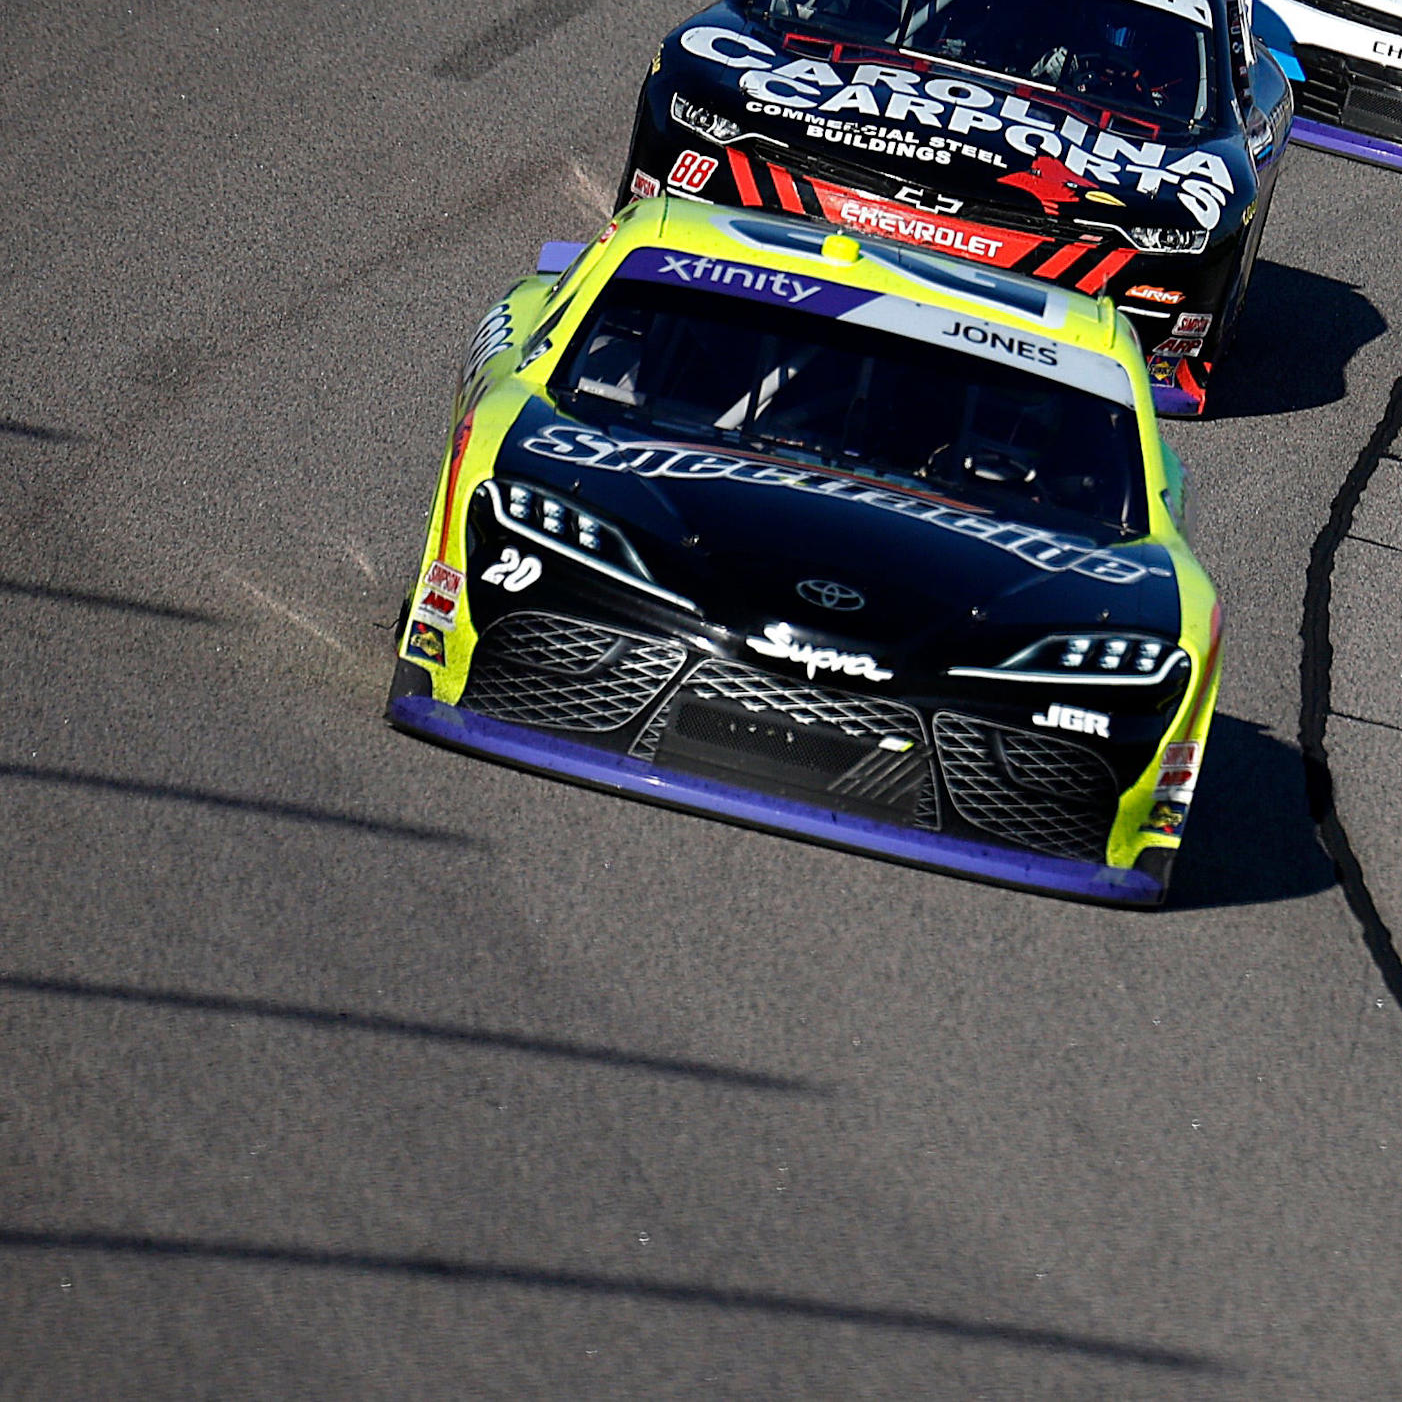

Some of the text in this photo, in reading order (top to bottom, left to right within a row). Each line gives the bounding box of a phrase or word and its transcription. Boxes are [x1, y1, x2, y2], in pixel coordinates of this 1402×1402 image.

[680, 25, 1235, 195] CAROLINA
[745, 100, 1008, 169] COMMERCIAL STEEL
[738, 69, 1227, 231] CARPORTS
[805, 124, 952, 166] BUILDINGS
[669, 150, 717, 192] 88
[840, 201, 1004, 258] CHEVROLET
[656, 254, 823, 304] xfinity
[1130, 287, 1181, 304] JRM
[942, 320, 1059, 367] JONES
[522, 424, 1150, 584] Spectracide
[480, 547, 543, 593] 20
[745, 621, 895, 683] Supra
[1031, 701, 1111, 739] JGR
